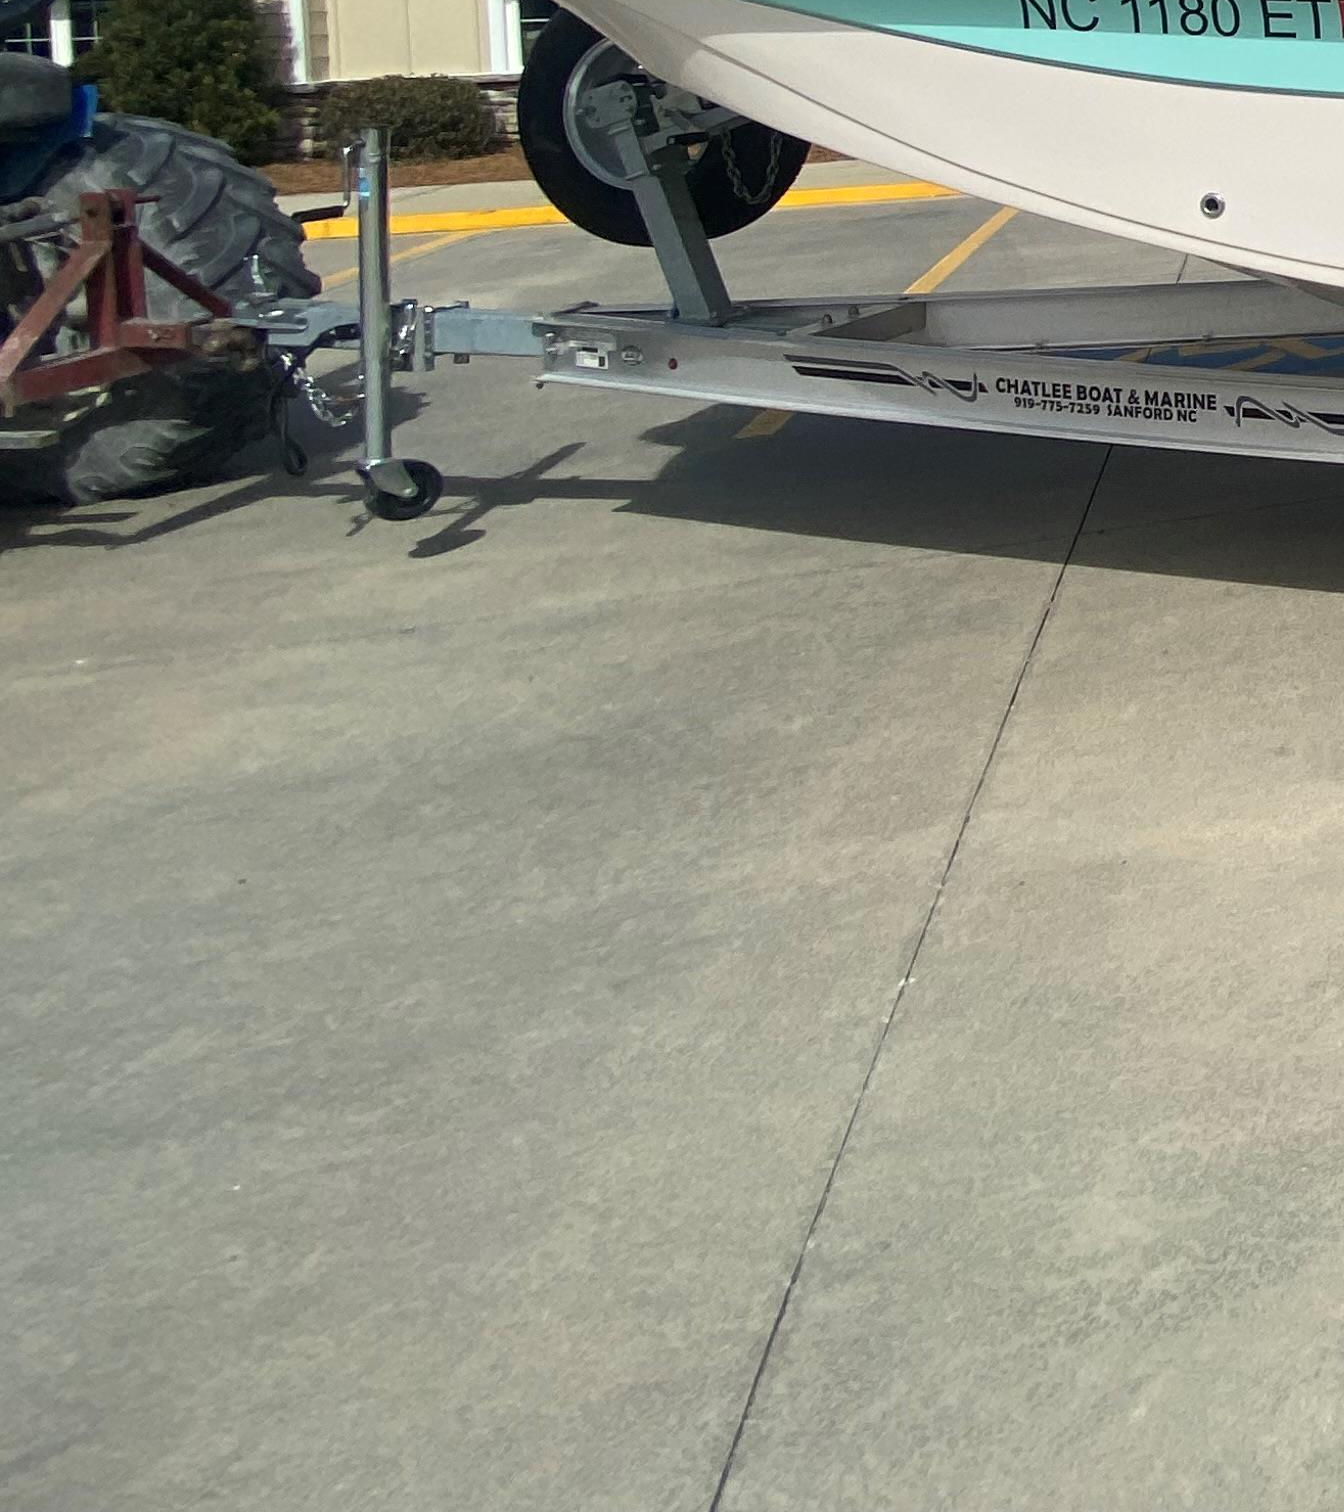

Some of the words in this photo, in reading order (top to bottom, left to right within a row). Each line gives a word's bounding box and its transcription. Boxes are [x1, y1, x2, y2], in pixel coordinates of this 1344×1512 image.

[995, 377, 1072, 400] CHATLEE
[1076, 385, 1123, 405] BOAT
[1127, 389, 1140, 405] &
[1144, 390, 1217, 410] MARINE
[1014, 396, 1100, 415] 919-775-7259
[1107, 405, 1174, 422] SANFORD
[1176, 409, 1197, 423] NC
